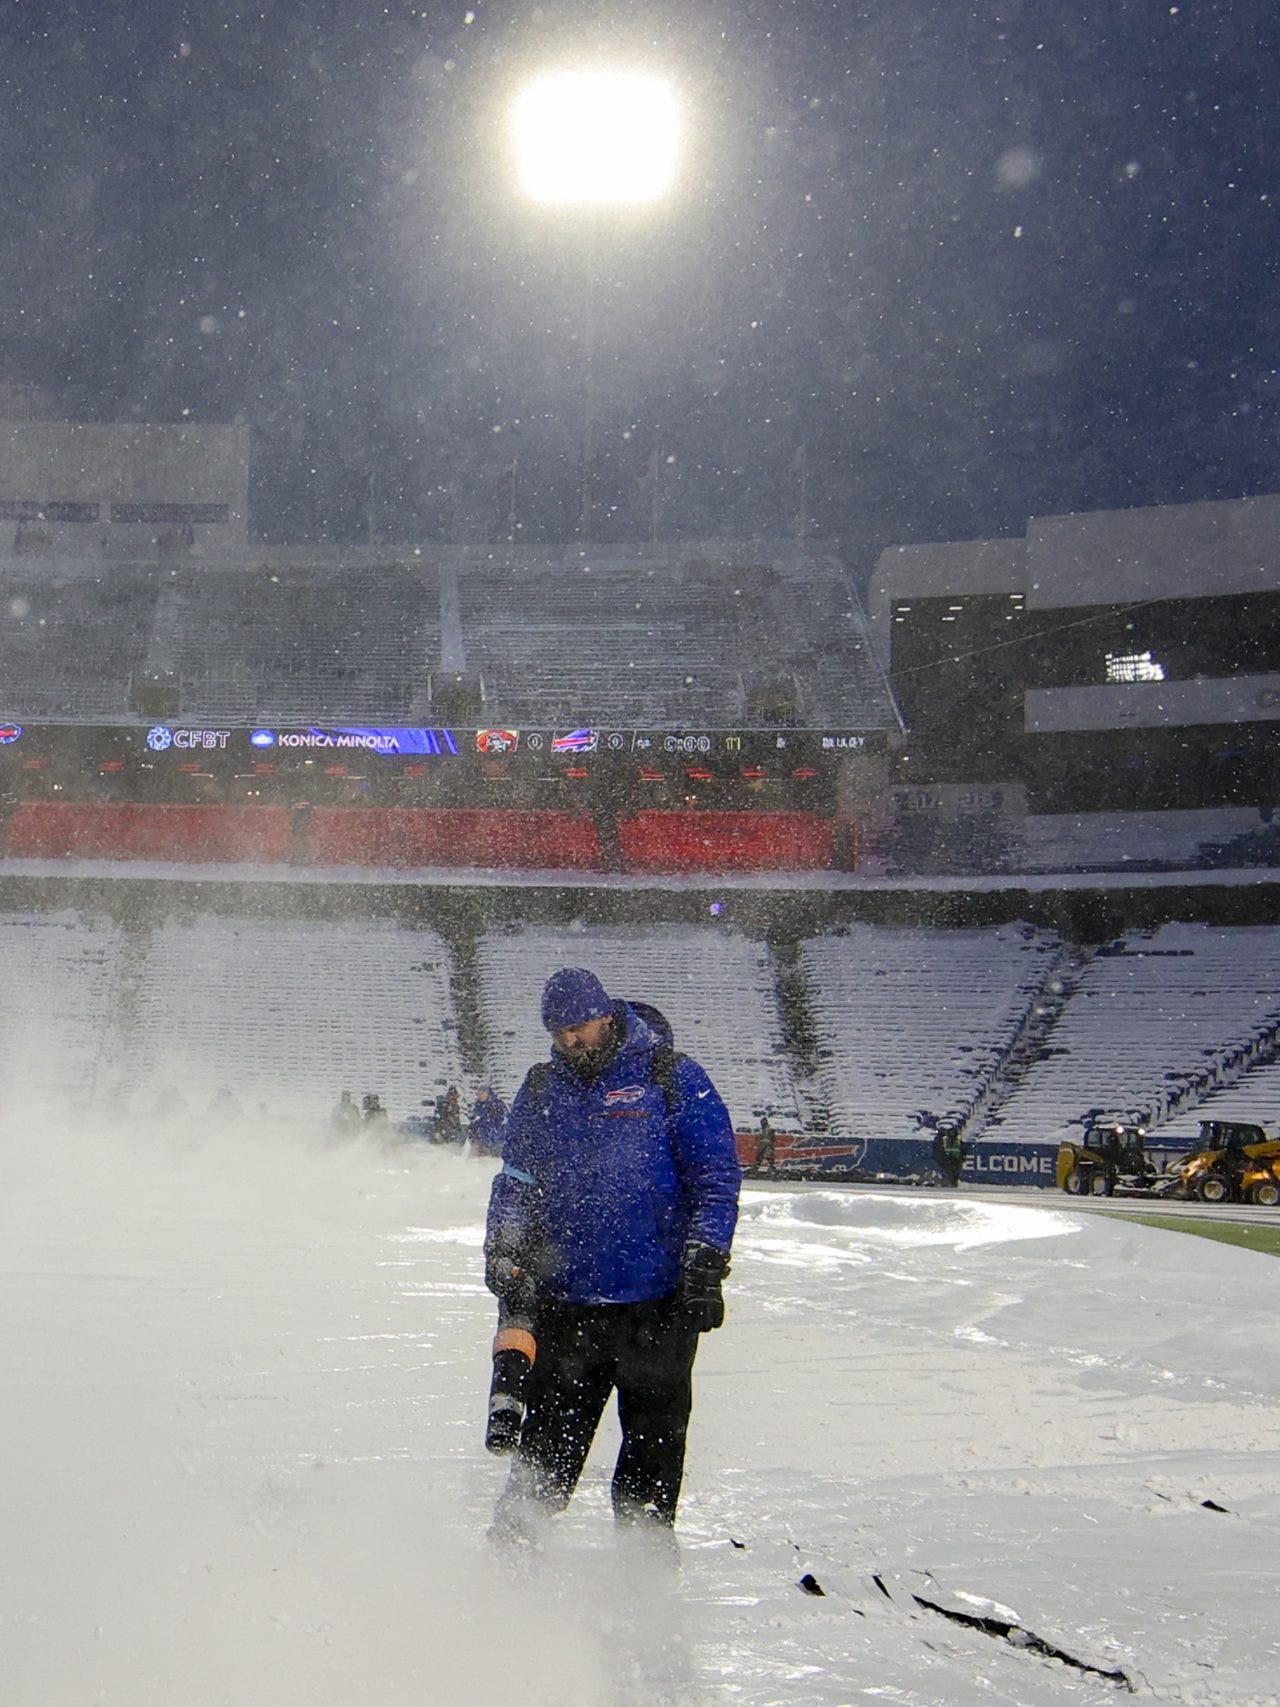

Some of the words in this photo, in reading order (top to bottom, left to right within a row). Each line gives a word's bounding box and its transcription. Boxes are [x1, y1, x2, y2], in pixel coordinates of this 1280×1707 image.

[172, 730, 231, 749] CFBT
[277, 733, 335, 748] KONICA
[336, 734, 400, 749] MINOLTA
[962, 1154, 1053, 1174] ELCOME
